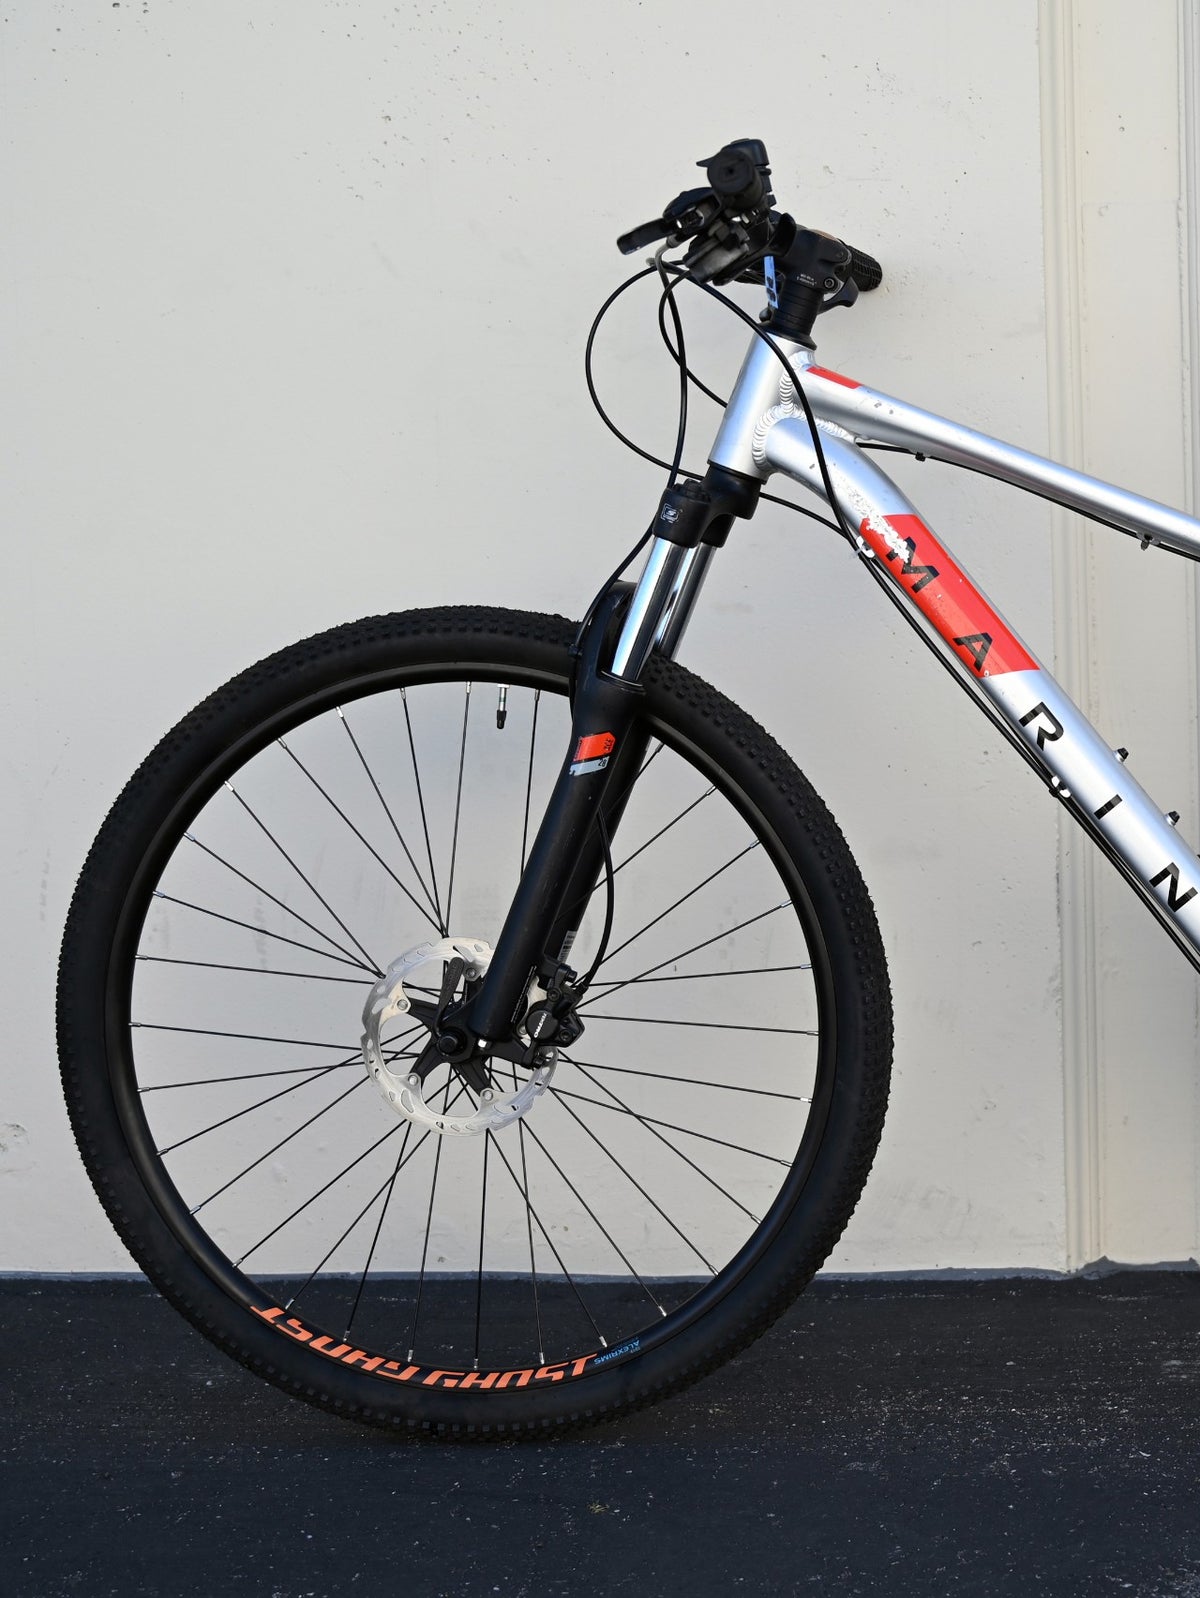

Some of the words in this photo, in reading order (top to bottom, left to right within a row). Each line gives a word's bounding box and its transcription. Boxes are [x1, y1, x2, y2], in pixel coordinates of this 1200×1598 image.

[886, 536, 1199, 913] MARIN
[250, 1305, 420, 1381] GHOST
[421, 1352, 598, 1389] GHOST
[593, 1339, 640, 1365] ALEXRIMS
